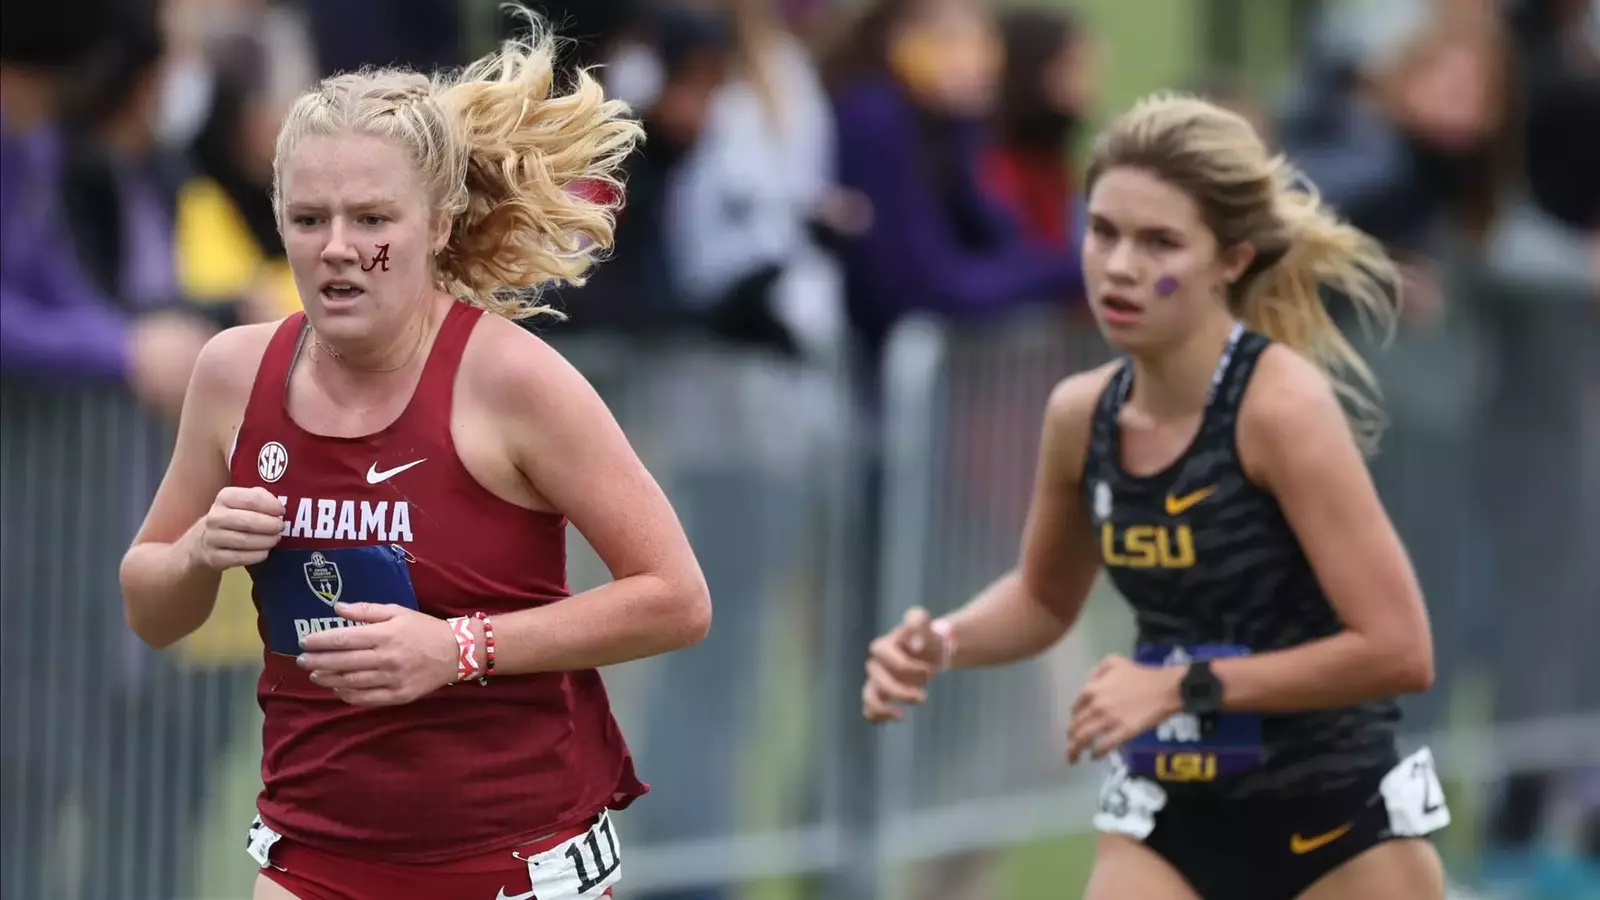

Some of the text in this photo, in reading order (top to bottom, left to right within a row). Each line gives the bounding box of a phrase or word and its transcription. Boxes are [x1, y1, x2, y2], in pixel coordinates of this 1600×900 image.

[360, 243, 390, 272] A
[259, 444, 286, 480] SEC
[277, 496, 413, 543] LABAMA
[1101, 521, 1196, 567] LSU
[1155, 752, 1217, 781] LSU
[565, 815, 620, 894] 111
